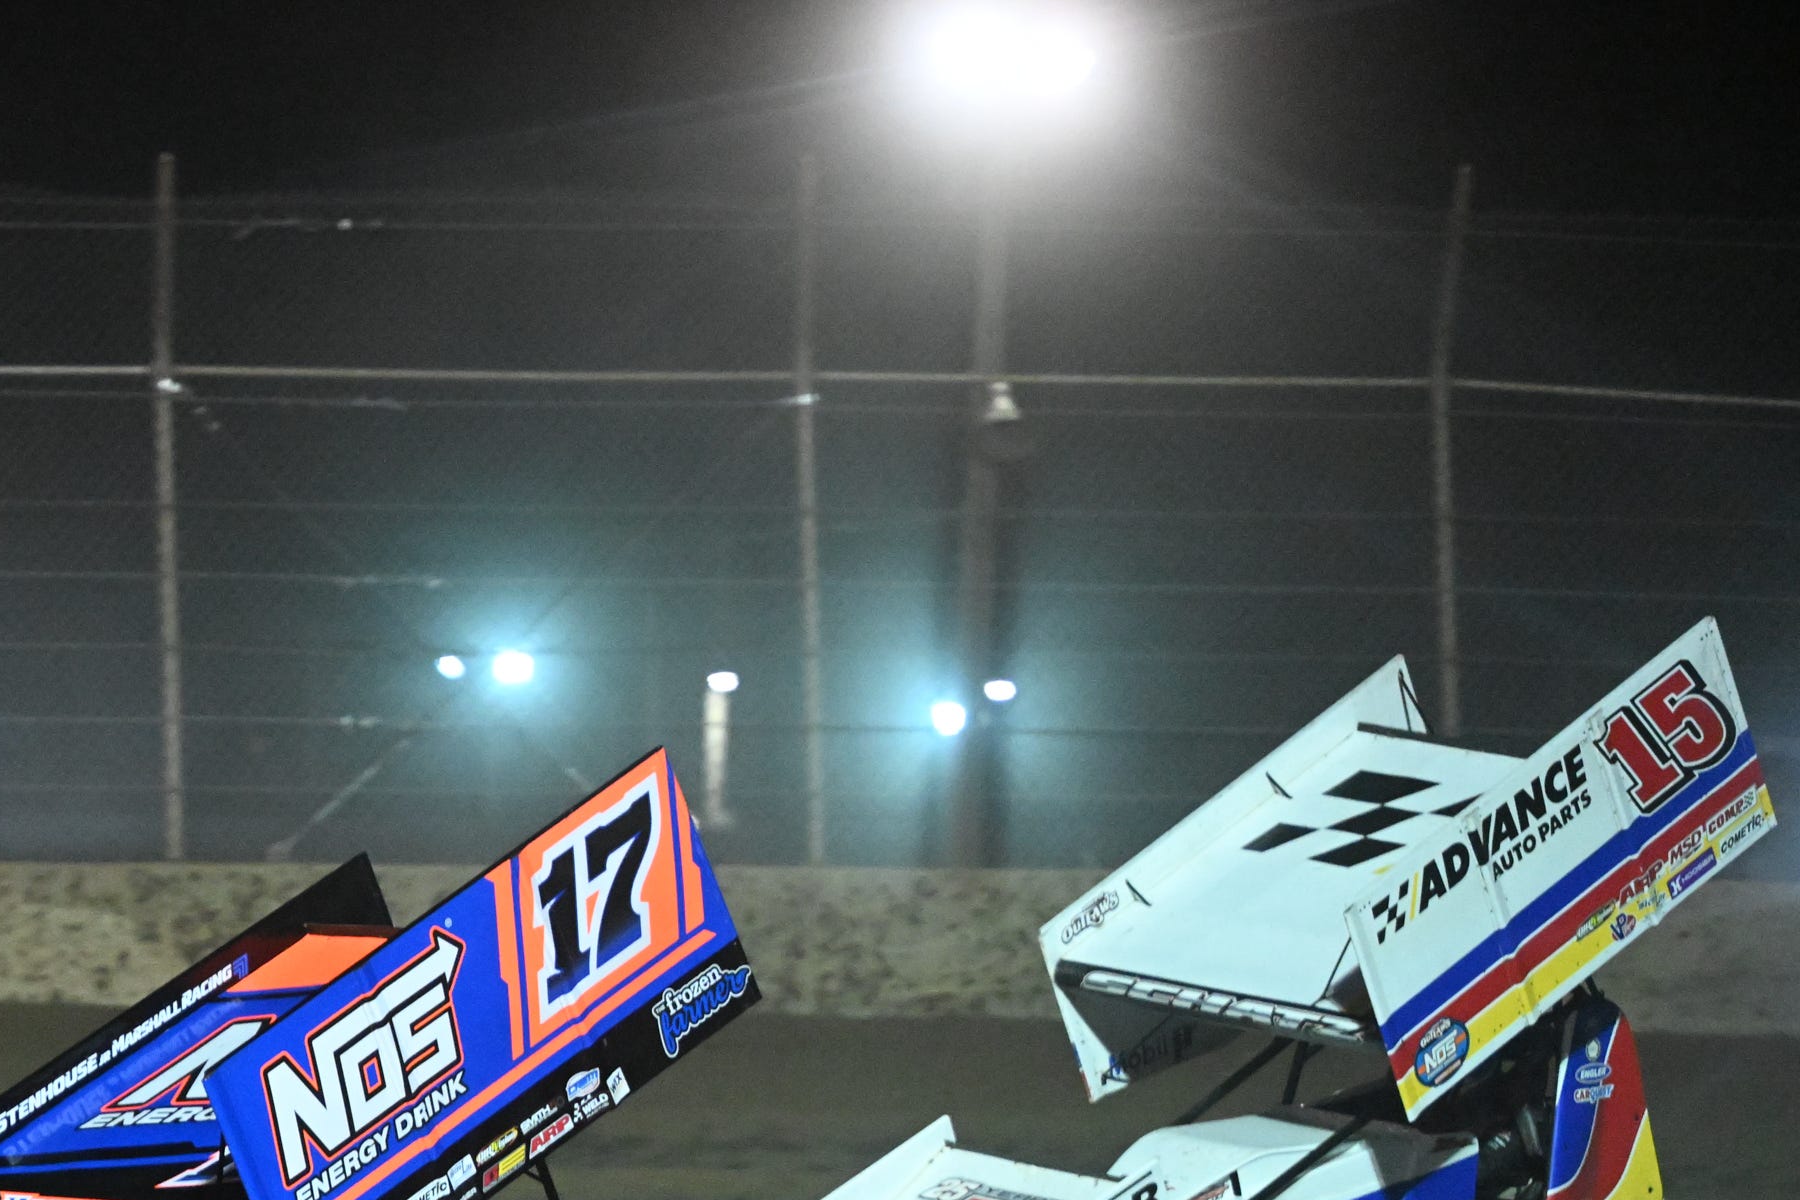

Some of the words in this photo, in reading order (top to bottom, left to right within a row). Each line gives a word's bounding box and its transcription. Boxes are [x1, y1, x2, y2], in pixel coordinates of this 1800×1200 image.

[1596, 660, 1737, 814] 15
[1418, 744, 1588, 913] ADVANCE
[1493, 833, 1537, 881] AUTO
[1538, 789, 1592, 842] PARTS
[1670, 831, 1701, 864] MSD
[1708, 799, 1743, 835] COMP
[536, 785, 656, 1003] 17
[111, 1001, 182, 1058] MARSHALL
[181, 964, 232, 1010] RACING
[661, 967, 749, 1055] farmer
[665, 968, 722, 1016] frozen
[262, 926, 465, 1188] NOS
[1423, 1029, 1457, 1074] NOS
[396, 1072, 468, 1143] DRINK
[531, 1116, 571, 1154] ARP
[583, 1093, 609, 1116] WELD
